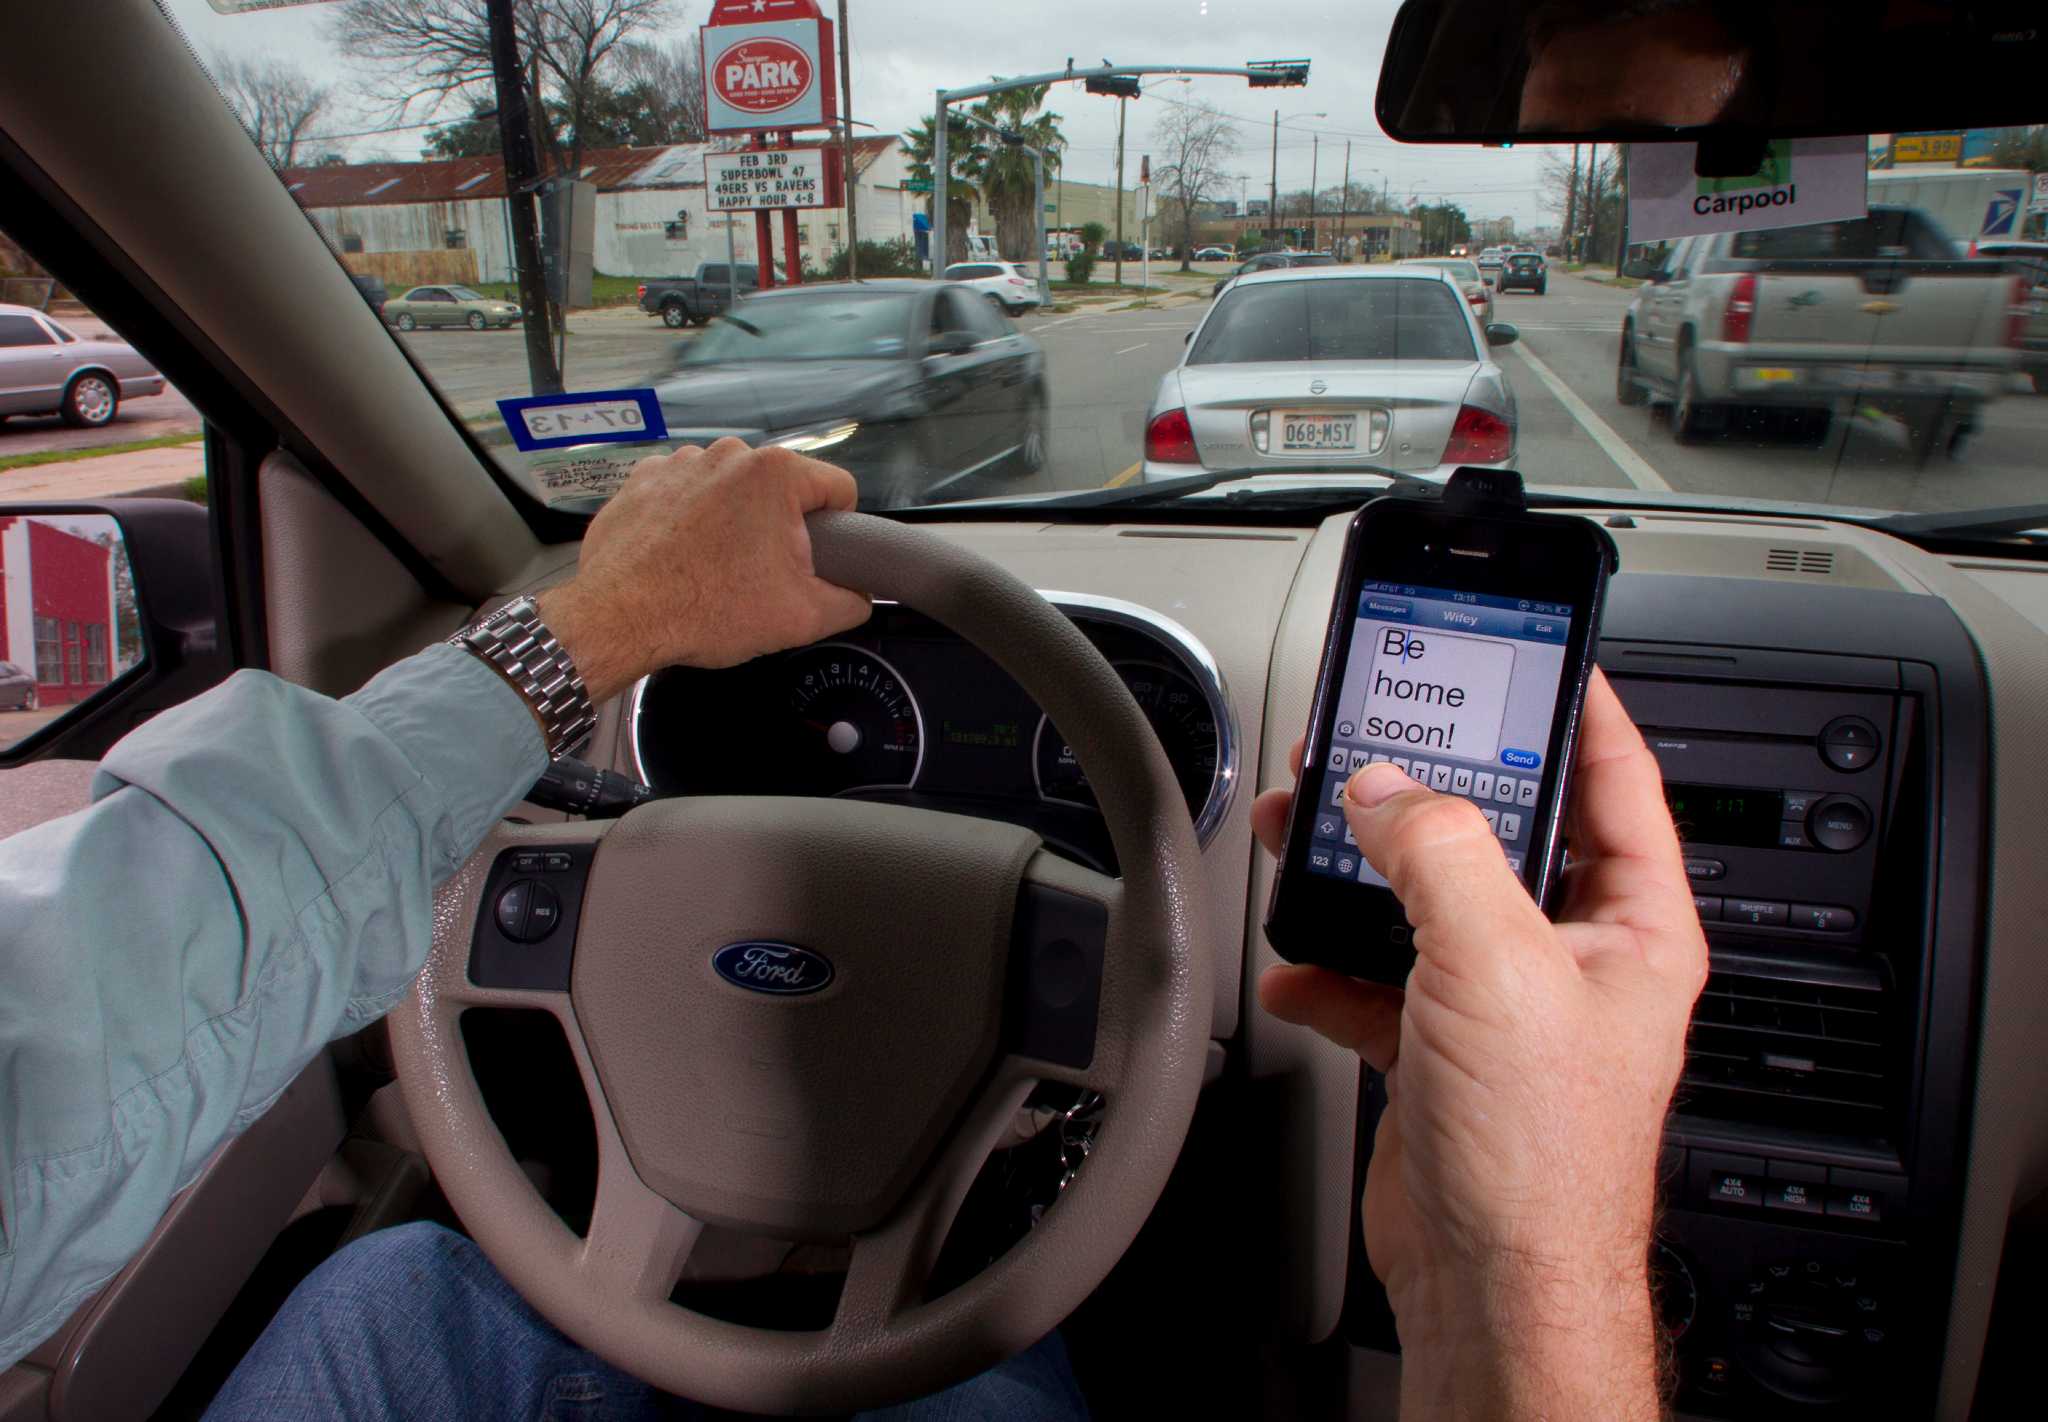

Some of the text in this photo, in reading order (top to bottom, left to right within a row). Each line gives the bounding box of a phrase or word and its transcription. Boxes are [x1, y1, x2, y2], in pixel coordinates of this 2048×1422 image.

[726, 60, 800, 90] PARK
[740, 153, 788, 167] FEB 3RD
[721, 166, 805, 181] SUPERBOWL 47
[715, 179, 815, 194] 49ERS VS RAVENS
[718, 193, 814, 208] HAPPY HOUR 4-8
[1694, 184, 1795, 215] Carpool
[1369, 601, 1553, 633] Messages Wifey Edit
[1383, 630, 1425, 659] Be
[1375, 670, 1465, 708] home
[1366, 717, 1455, 749] soon!
[1332, 753, 1343, 766] Q
[1506, 752, 1534, 765] Send
[1312, 855, 1329, 866] 123
[735, 948, 806, 984] Ford
[1719, 1186, 1745, 1197] AUTO
[1783, 1194, 1807, 1204] HIGH
[1850, 1202, 1872, 1213] LOW
